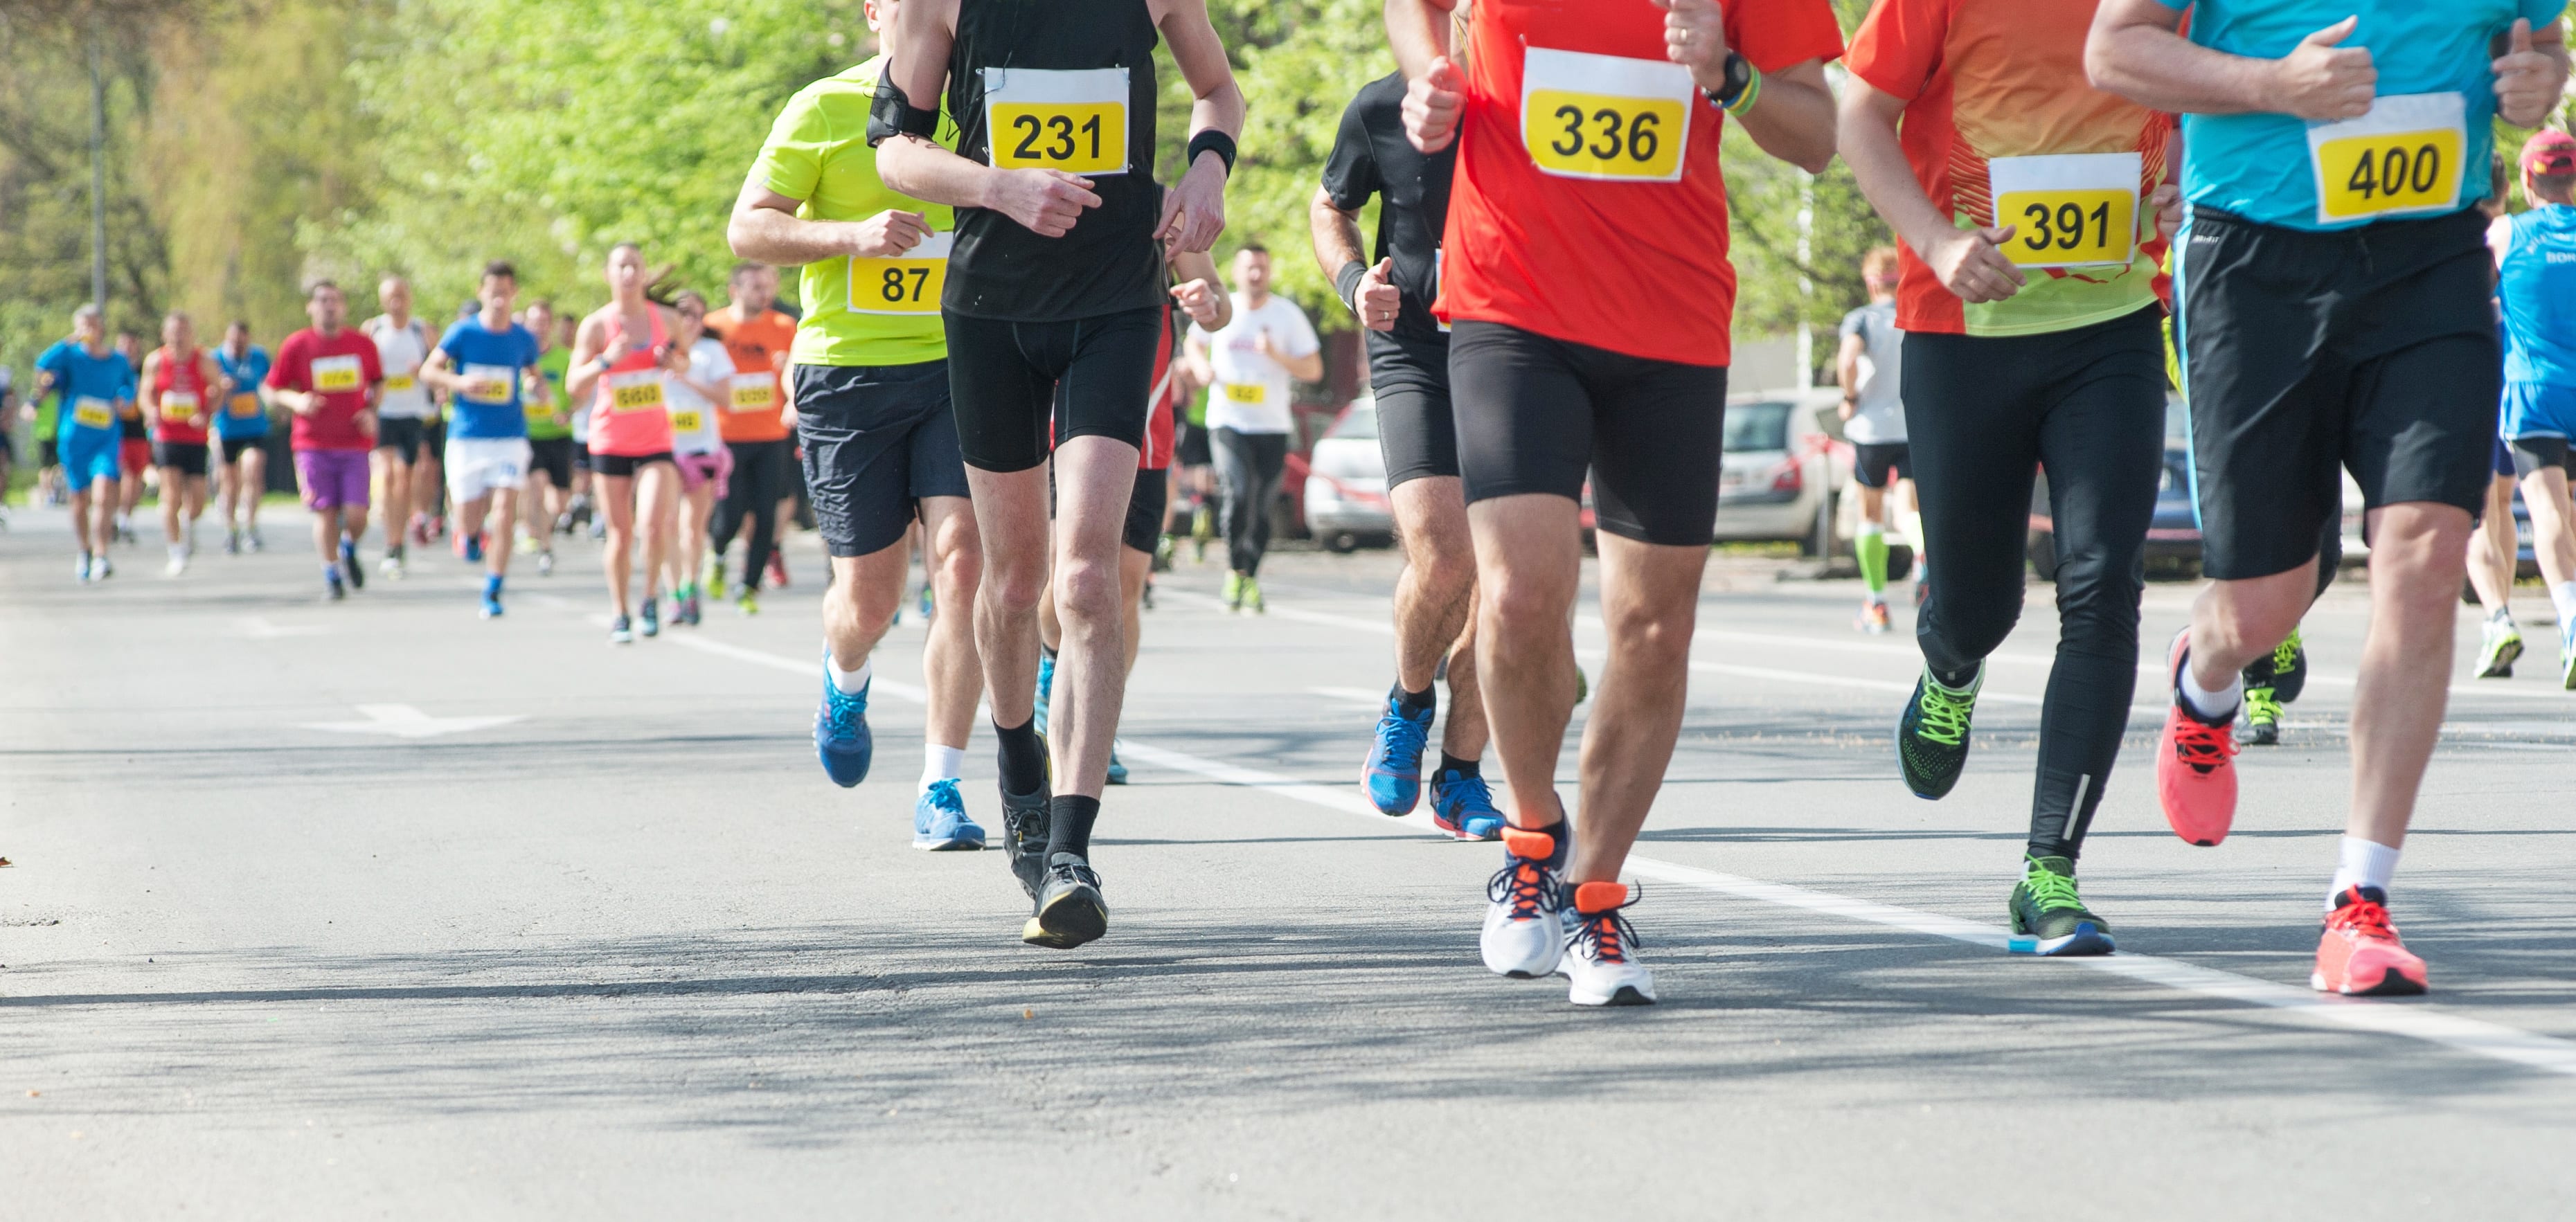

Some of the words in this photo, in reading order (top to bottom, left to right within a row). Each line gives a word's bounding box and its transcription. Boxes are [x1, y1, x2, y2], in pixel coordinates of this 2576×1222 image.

[1013, 114, 1100, 161] 231
[1553, 106, 1659, 162] 336
[2348, 145, 2438, 199] 400
[2024, 201, 2110, 251] 391
[882, 267, 930, 303] 87
